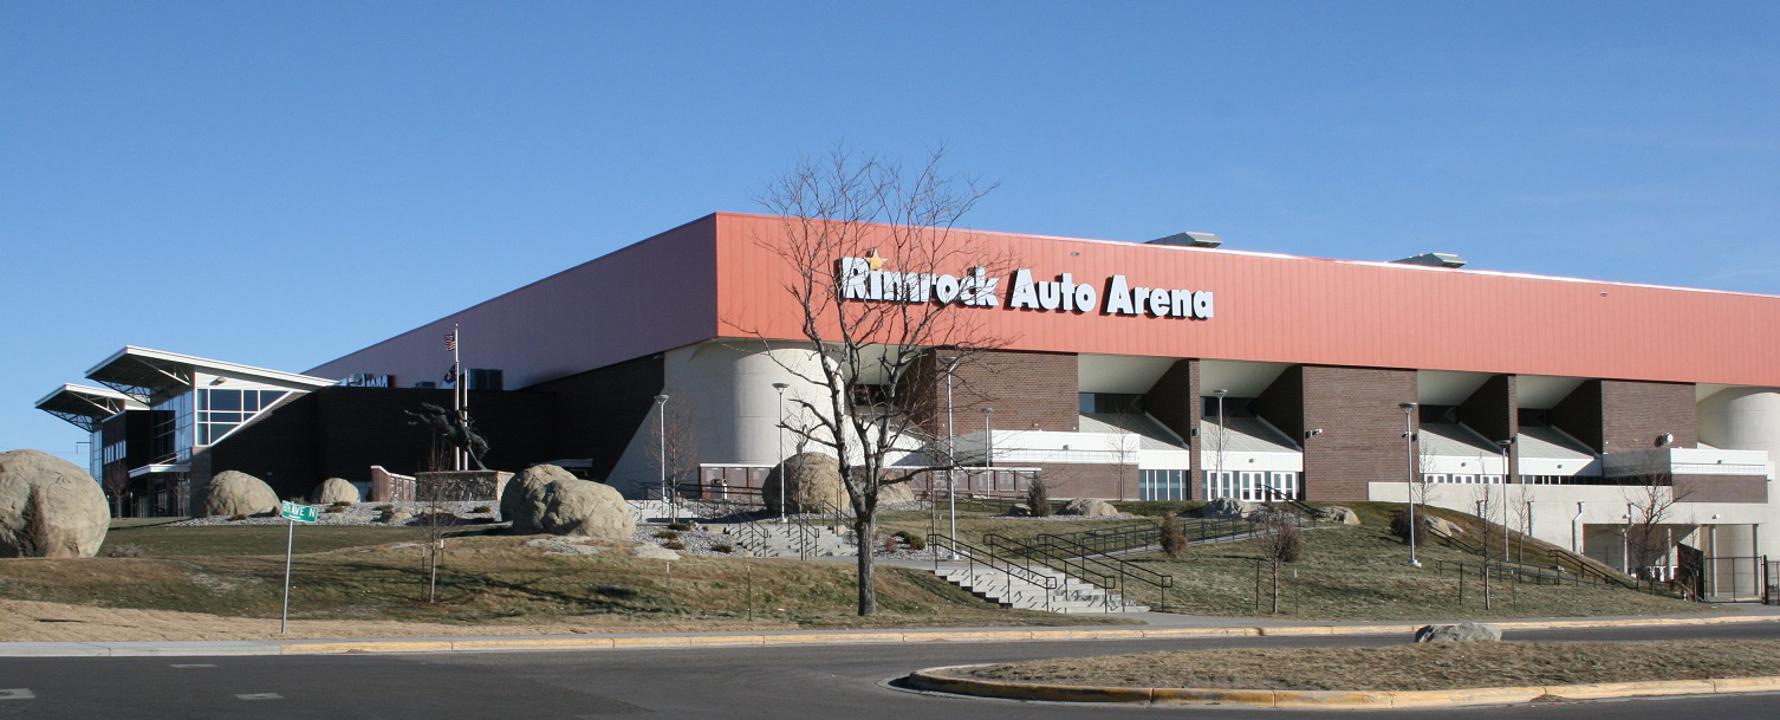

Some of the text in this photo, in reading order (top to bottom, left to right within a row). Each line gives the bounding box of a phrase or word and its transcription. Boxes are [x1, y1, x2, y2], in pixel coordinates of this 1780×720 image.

[842, 249, 1214, 318] Rimrock Auto Arena
[291, 505, 305, 516] AVE
[309, 507, 316, 518] N
